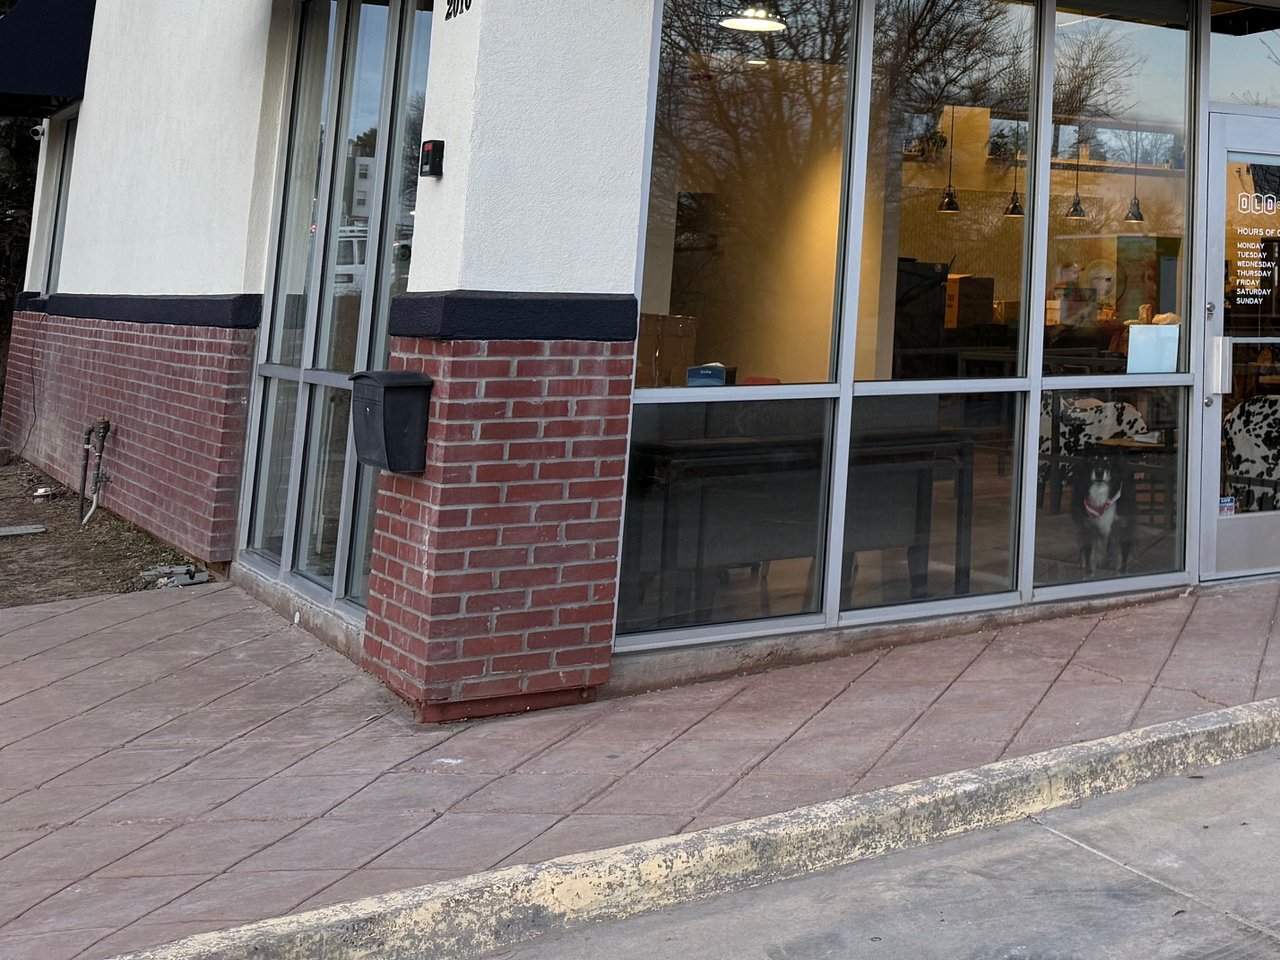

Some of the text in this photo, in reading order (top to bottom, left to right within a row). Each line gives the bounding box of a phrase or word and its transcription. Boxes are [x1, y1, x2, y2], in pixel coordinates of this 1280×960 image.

[1240, 196, 1274, 212] OLD
[1237, 227, 1264, 236] HOURS
[1265, 228, 1276, 236] OF
[1236, 251, 1268, 259] TUESDAY
[1236, 260, 1276, 268] WEDNESDAY
[1236, 269, 1272, 277] THURSDAY
[1236, 288, 1272, 296] SATURDAY
[1236, 297, 1264, 305] SUNDAY
